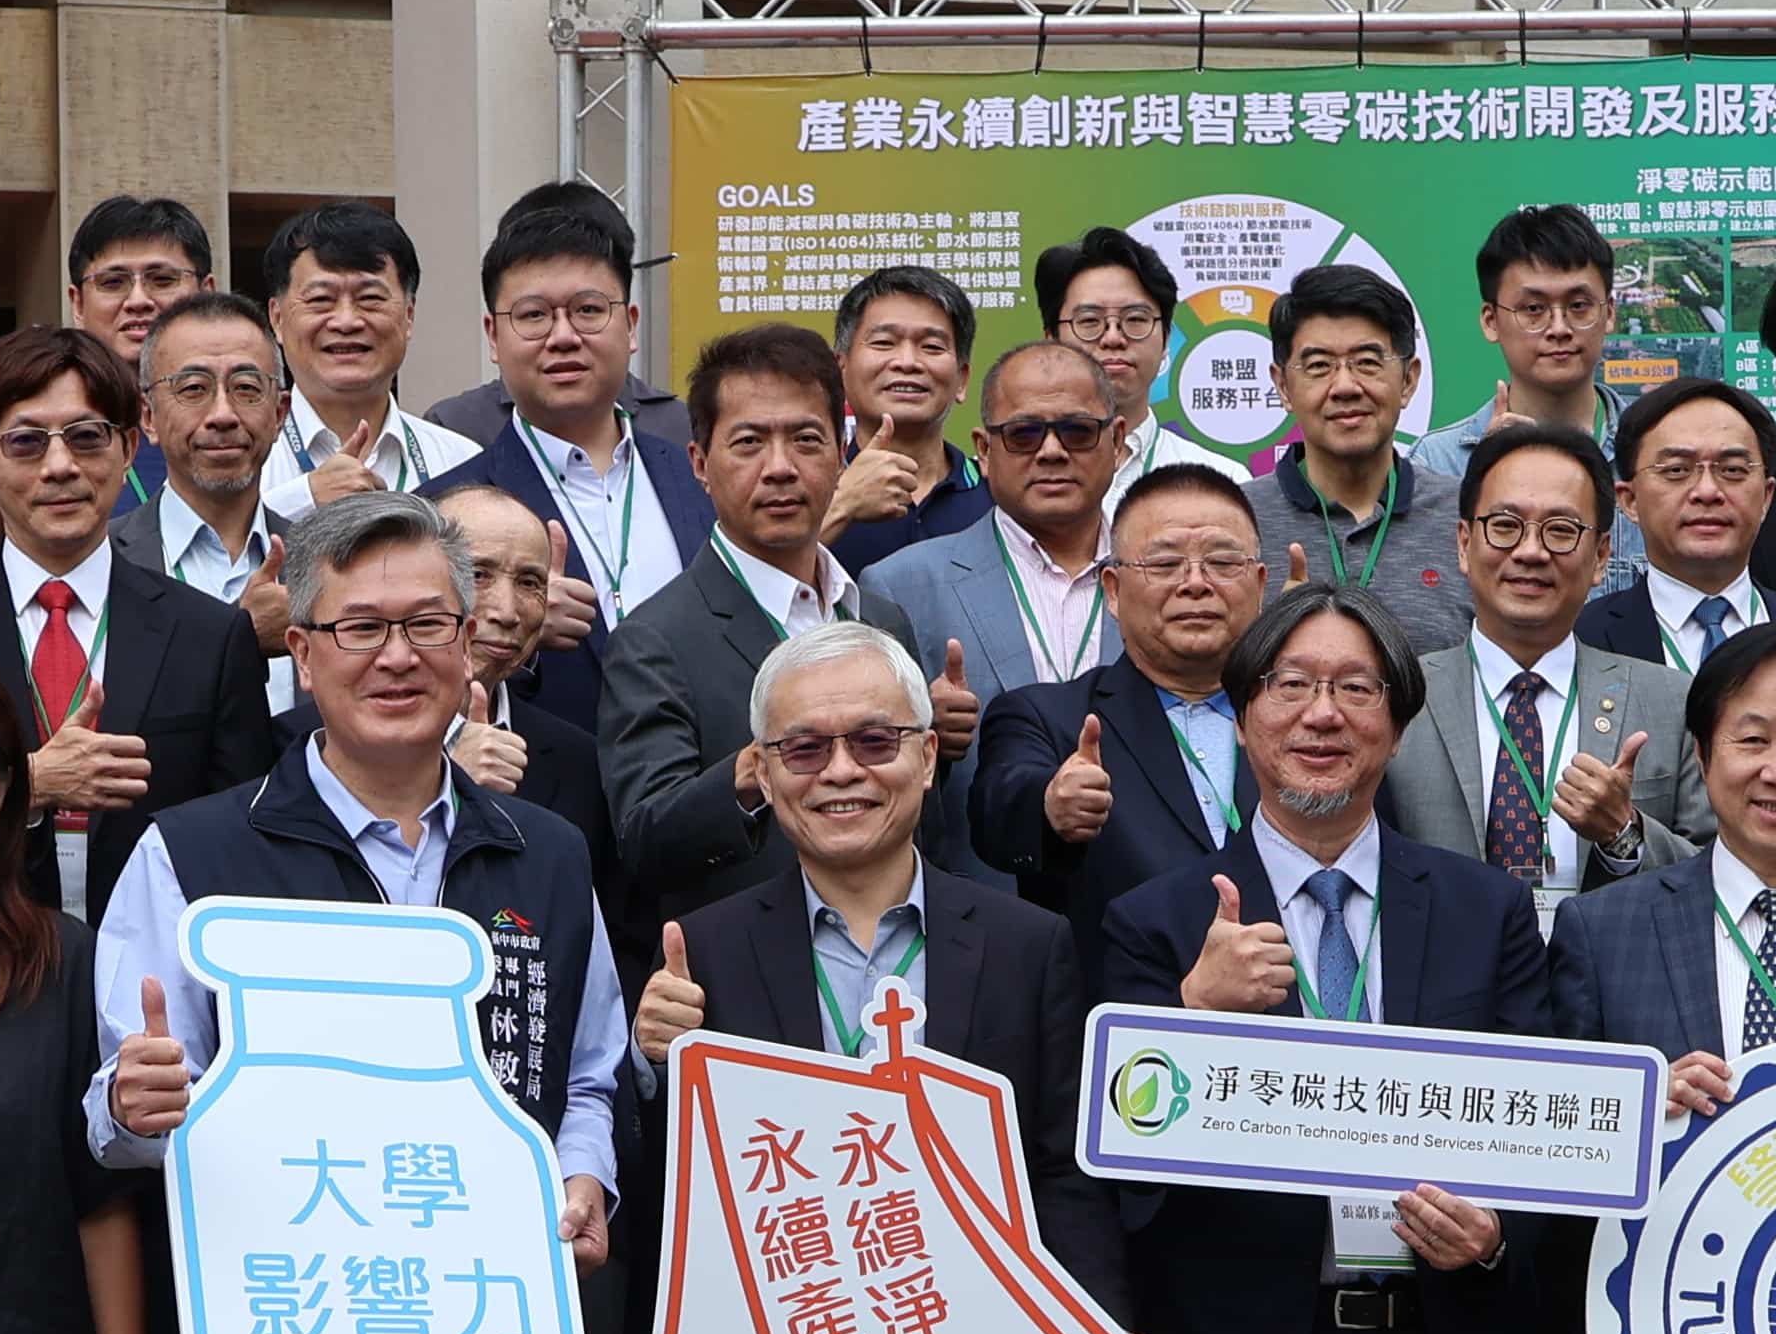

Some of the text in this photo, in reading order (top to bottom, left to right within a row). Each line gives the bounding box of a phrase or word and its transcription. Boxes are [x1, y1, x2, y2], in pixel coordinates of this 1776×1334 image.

[717, 184, 816, 208] GOALS
[1191, 387, 1284, 411] 服務平台
[1211, 358, 1258, 382] 聯盟
[489, 1005, 521, 1103] 林敏
[527, 958, 547, 1101] 經濟發展局
[1202, 1063, 1624, 1134] 淨零碳技術與服務聯盟
[1201, 1114, 1612, 1164] Zero Carbon Technologies and Services Alliance (ZCTSA)
[280, 1138, 471, 1230] 大學
